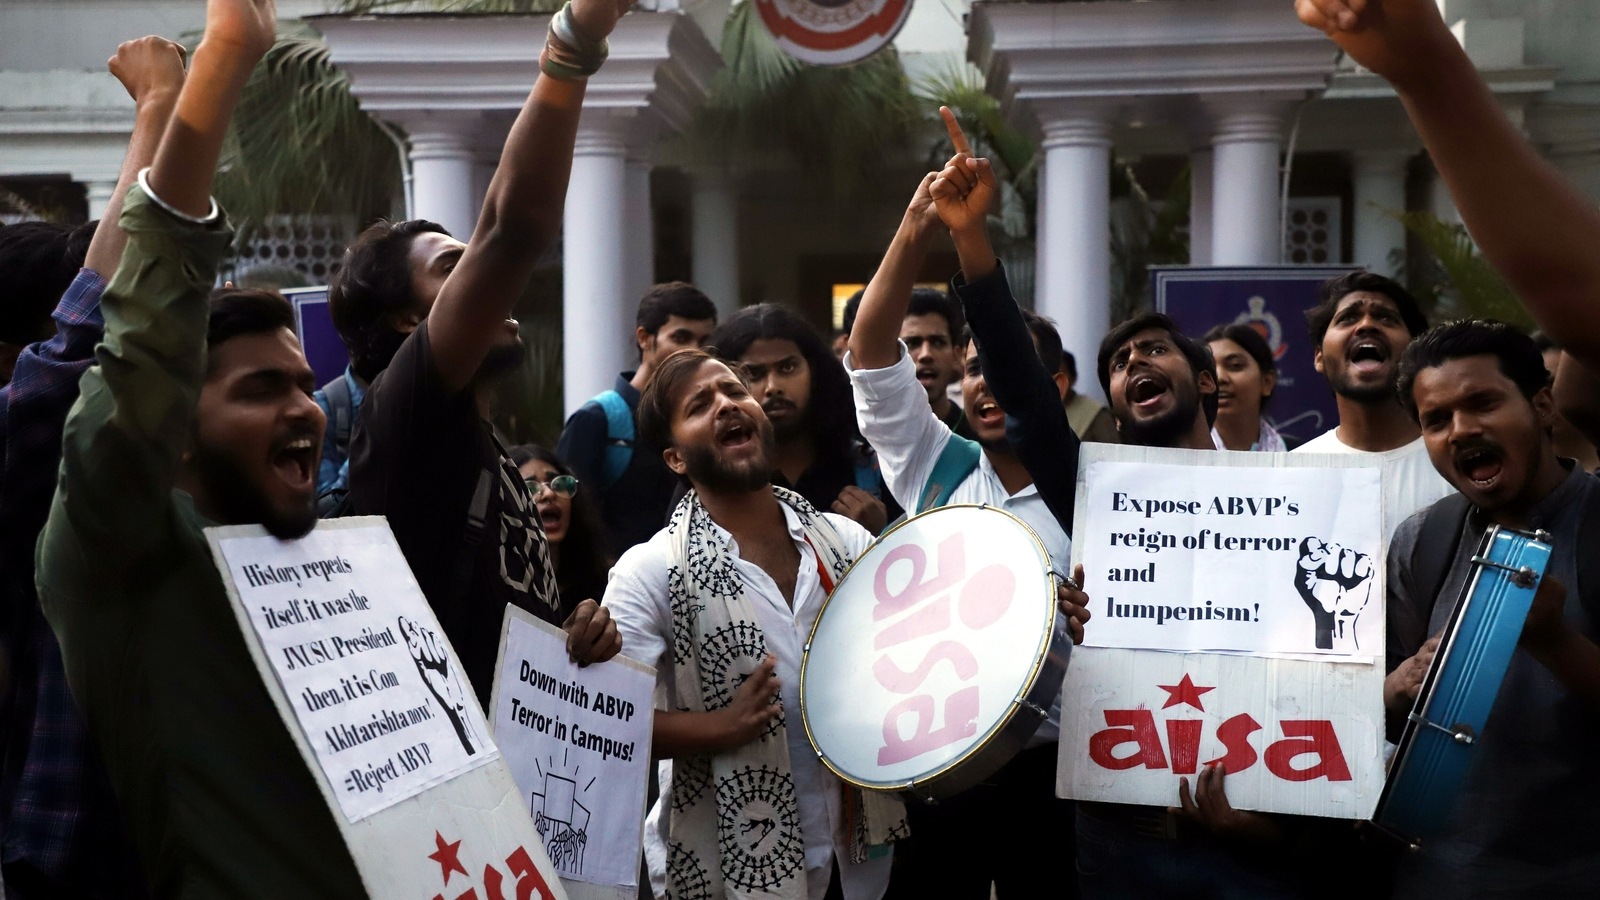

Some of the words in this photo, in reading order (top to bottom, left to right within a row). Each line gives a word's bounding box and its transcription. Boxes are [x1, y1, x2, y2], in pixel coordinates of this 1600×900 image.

[1111, 492, 1201, 518] Expose
[1206, 495, 1300, 516] ABVP's
[1110, 527, 1177, 553] reign
[1182, 529, 1211, 550] of
[1214, 532, 1297, 551] terror
[241, 563, 303, 588] History
[301, 556, 353, 582] repeats
[1107, 563, 1156, 583] and
[303, 598, 324, 621] it
[322, 596, 353, 617] was
[349, 589, 371, 611] the
[1106, 597, 1260, 625] lumpenism!
[282, 638, 335, 670] JNUSU
[331, 627, 398, 658] President
[340, 678, 359, 701] it
[352, 674, 373, 696] is
[369, 669, 400, 691] Com
[519, 659, 557, 695] Down
[558, 680, 589, 710] with
[592, 692, 635, 722] ABVP
[325, 709, 410, 755] Akhtarishta
[407, 697, 436, 725] now!
[511, 698, 552, 735] Terror
[554, 717, 567, 741] in
[571, 723, 635, 762] Campus!
[1089, 673, 1353, 782] aisa
[397, 742, 433, 775] ABVP
